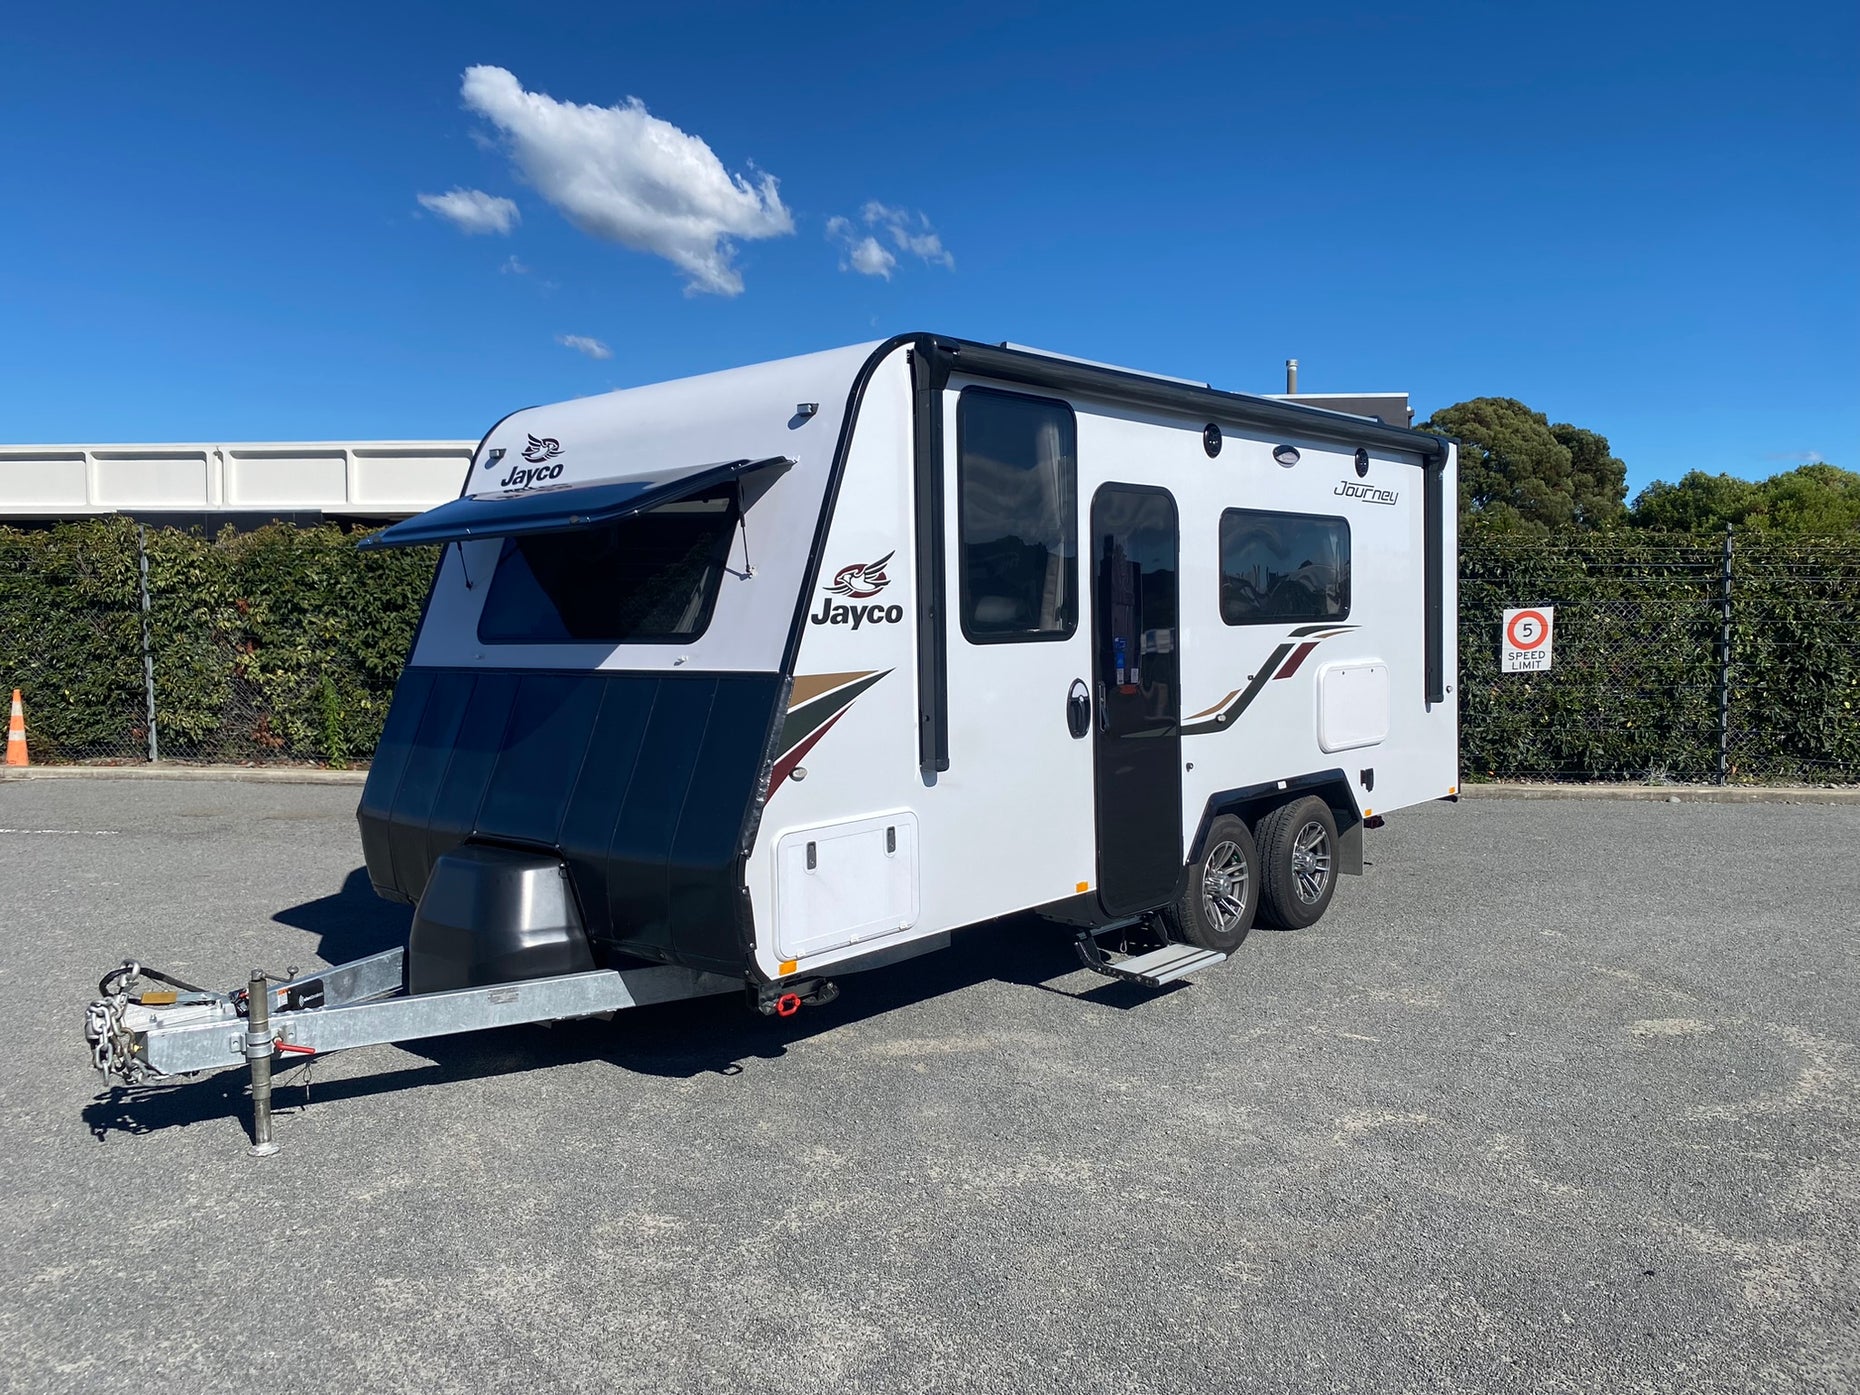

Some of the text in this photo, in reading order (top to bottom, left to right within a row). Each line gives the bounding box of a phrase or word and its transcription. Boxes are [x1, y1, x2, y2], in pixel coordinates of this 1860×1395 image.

[501, 464, 564, 488] Jayco
[1333, 480, 1399, 505] Journey
[811, 598, 903, 630] Jayco
[1522, 623, 1533, 638] 5
[1508, 650, 1546, 661] SPEED
[1511, 660, 1542, 670] LIMIT
